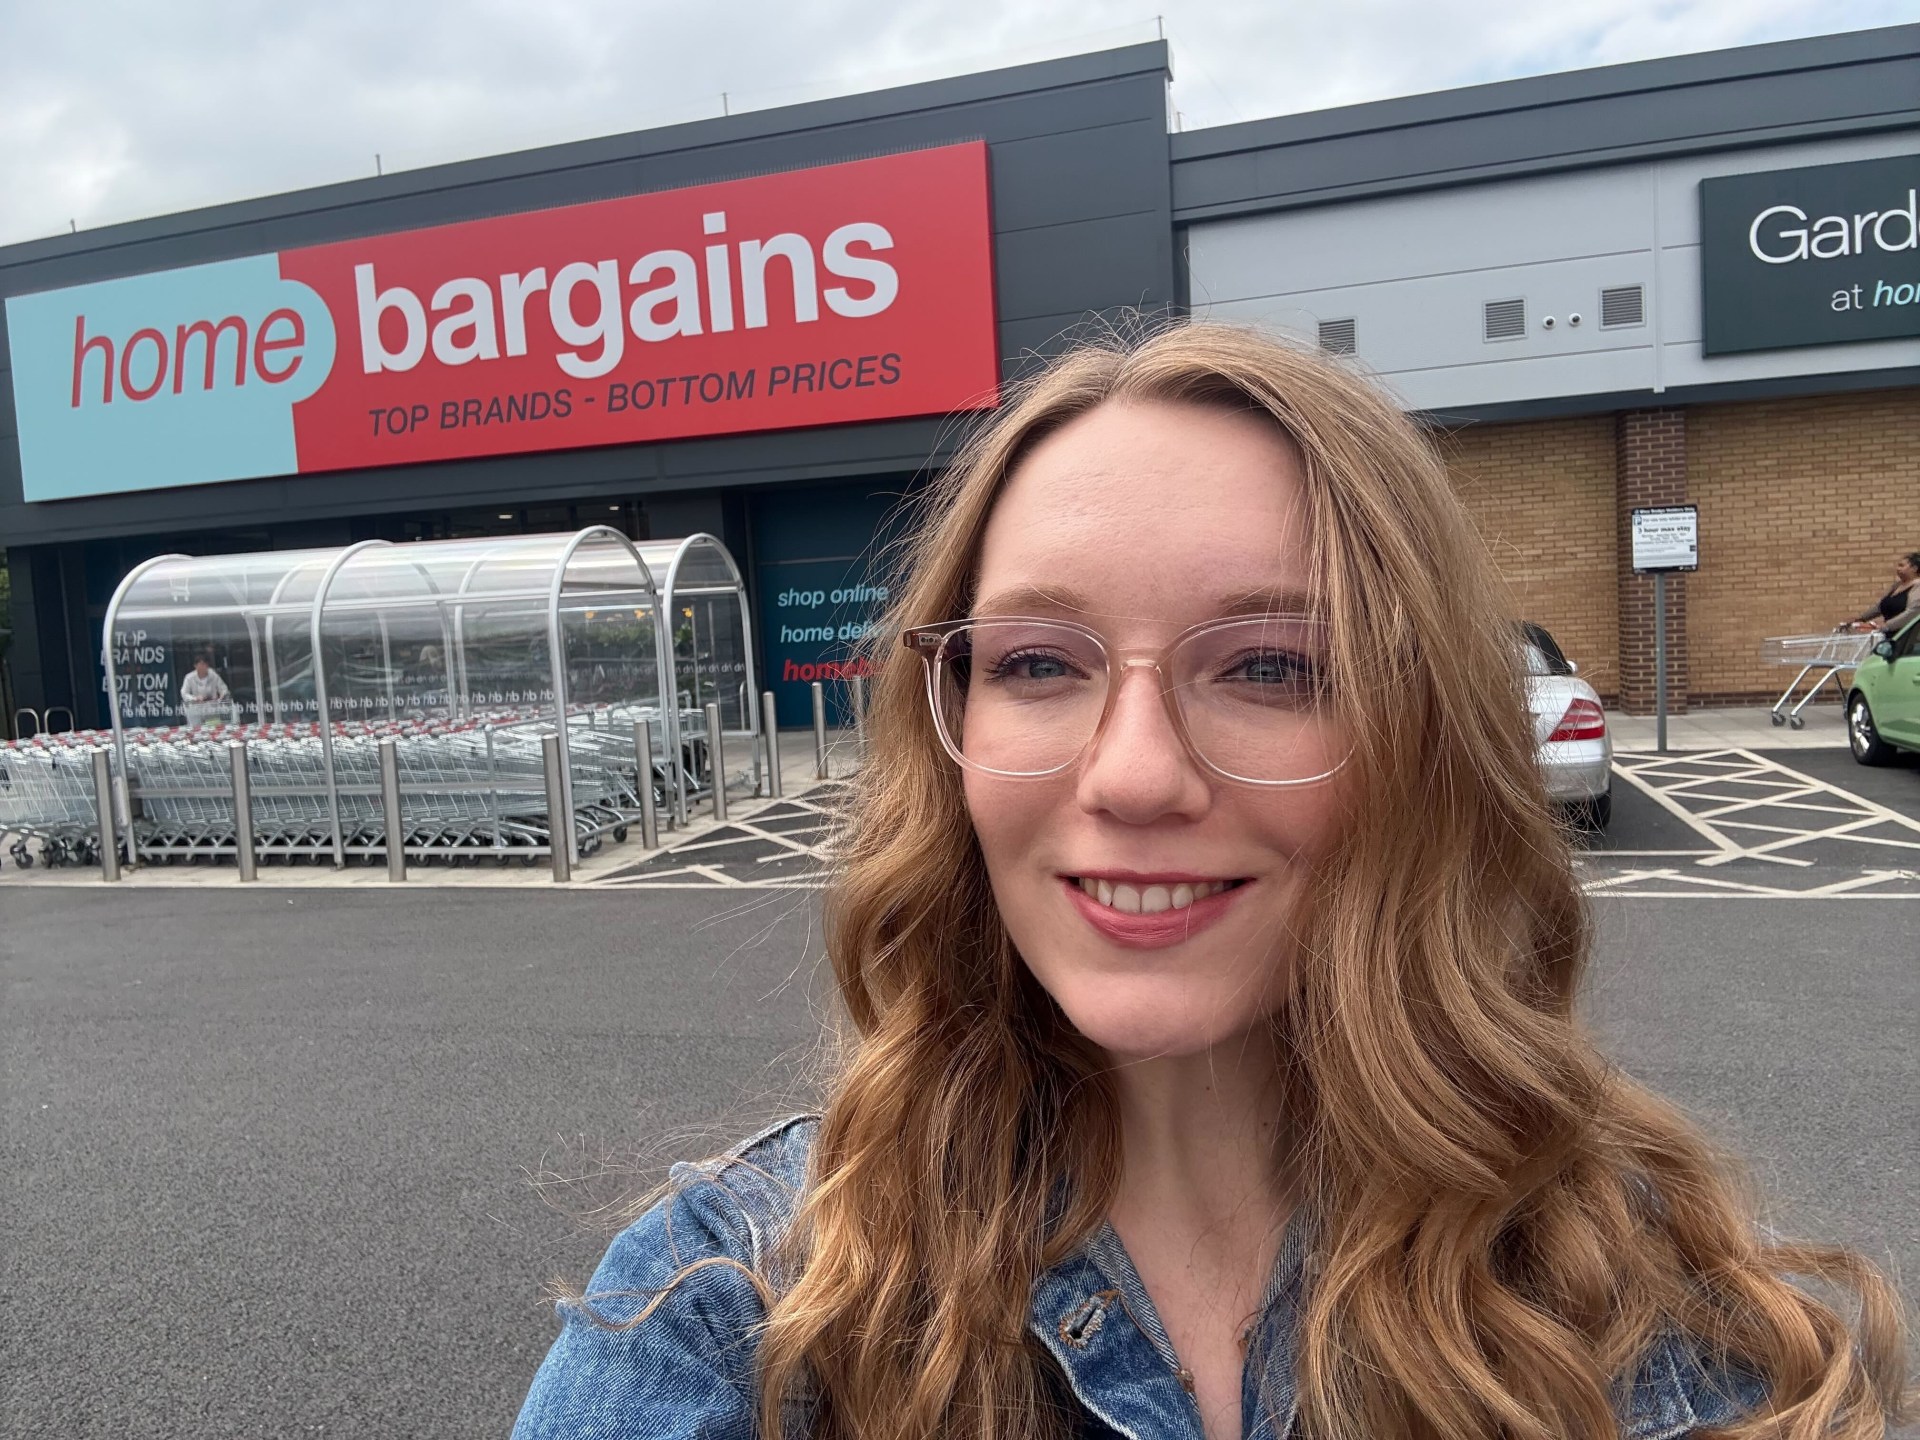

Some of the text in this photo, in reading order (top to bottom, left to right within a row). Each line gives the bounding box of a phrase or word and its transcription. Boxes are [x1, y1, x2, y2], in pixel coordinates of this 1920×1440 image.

[1749, 188, 1920, 264] Gard
[71, 210, 899, 408] home bargains
[1831, 284, 1863, 312] at
[369, 404, 429, 437] TOP
[440, 388, 573, 431] BRANDS
[606, 369, 756, 413] BOTTOM
[767, 352, 902, 399] PRICES
[777, 584, 889, 609] shop online
[780, 624, 834, 643] home
